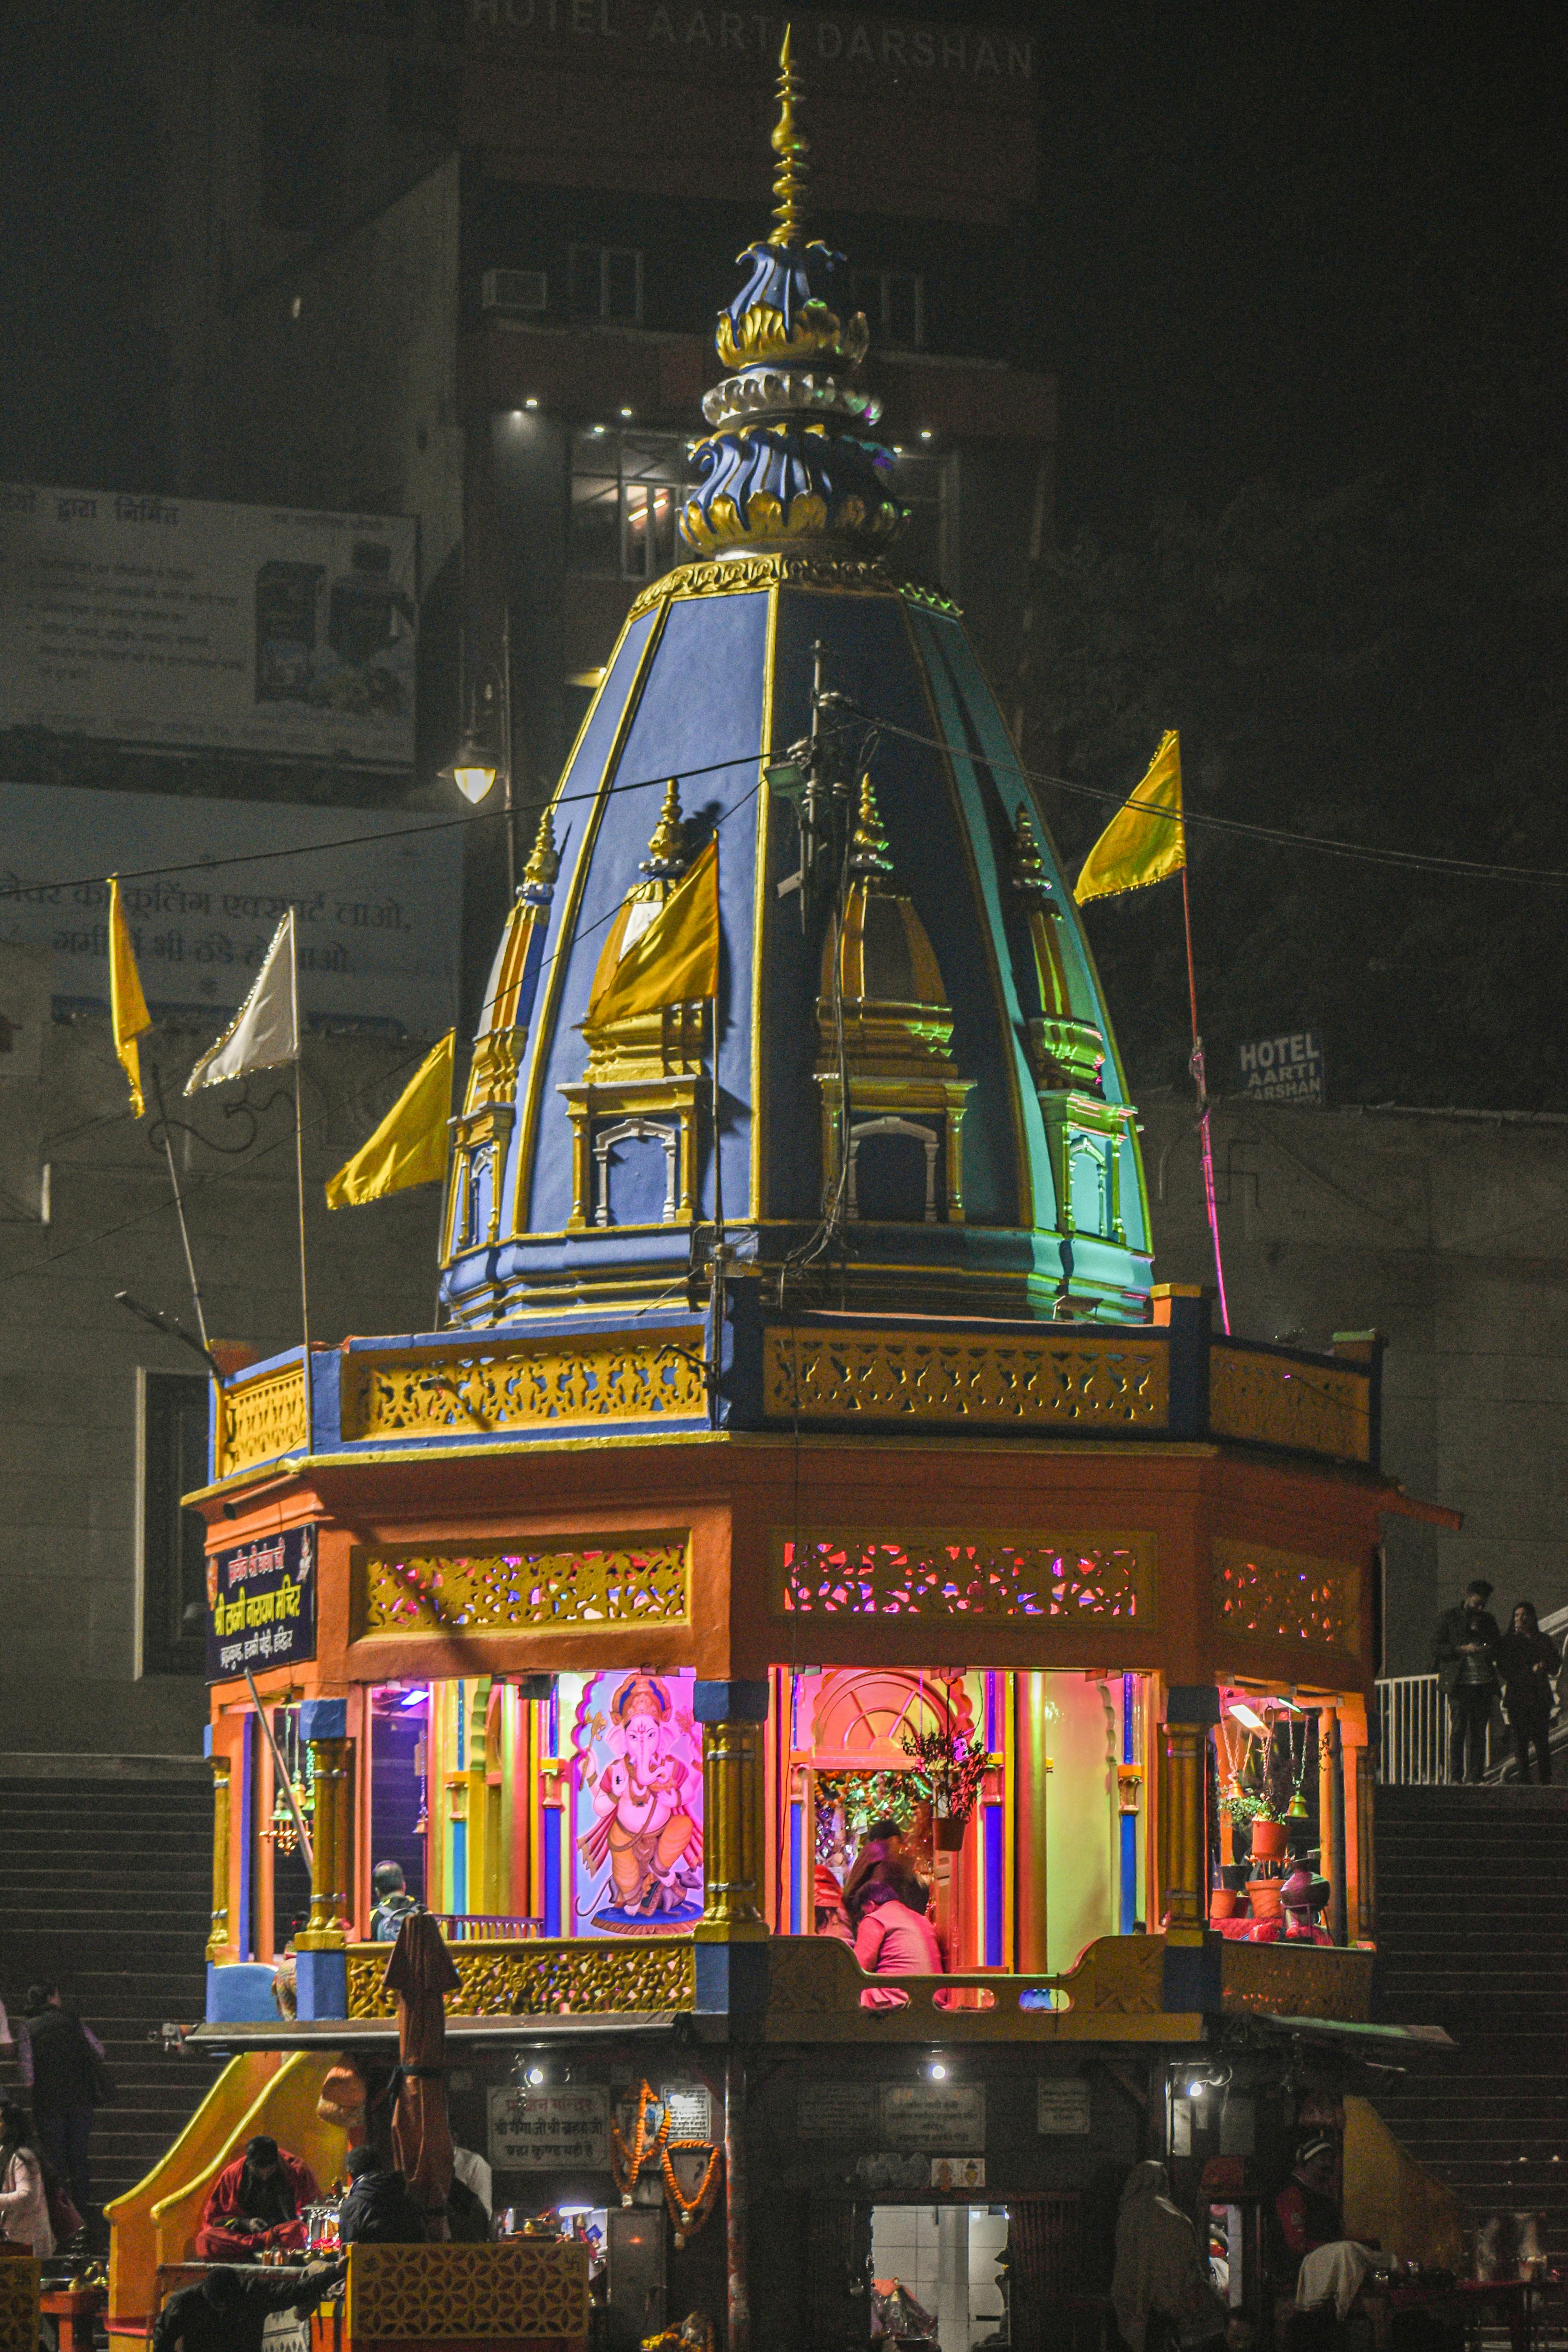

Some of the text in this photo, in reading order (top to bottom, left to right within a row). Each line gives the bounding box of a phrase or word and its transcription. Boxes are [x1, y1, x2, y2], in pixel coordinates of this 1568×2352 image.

[645, 6, 788, 52] AART
[817, 21, 1035, 79] DARSHAN
[1240, 1032, 1320, 1071] HOTEL
[1248, 1062, 1315, 1088] AARTI
[1253, 1077, 1321, 1101] ARSHAN
[214, 1592, 225, 1636] श्री
